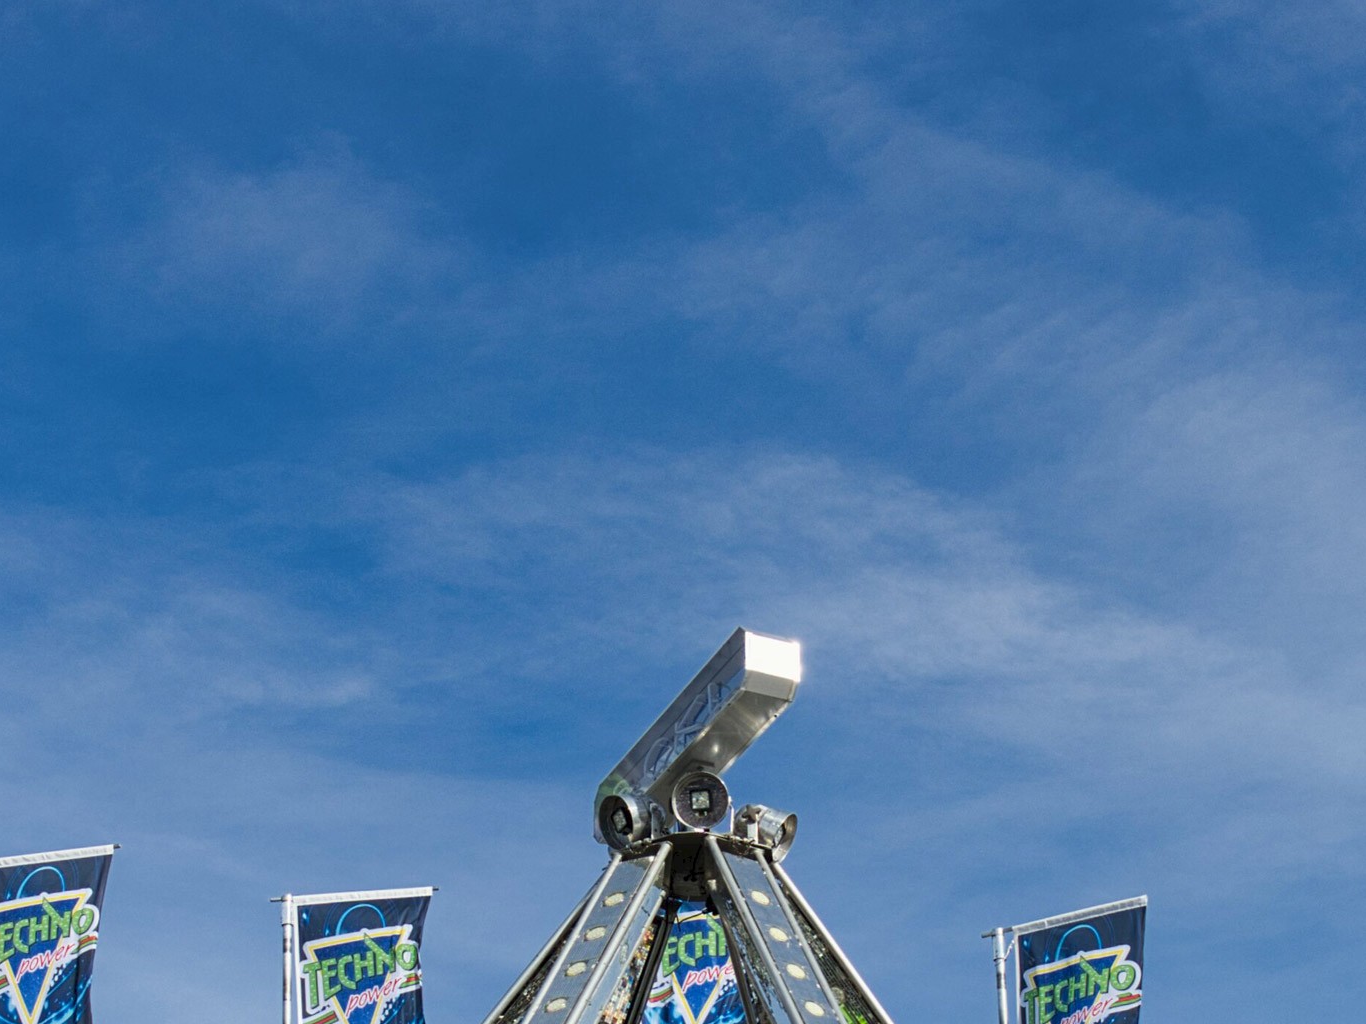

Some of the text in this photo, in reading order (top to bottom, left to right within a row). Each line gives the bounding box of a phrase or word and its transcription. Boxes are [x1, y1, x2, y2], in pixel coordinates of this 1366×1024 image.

[17, 943, 74, 981] power
[303, 932, 419, 1009] TECHNO
[683, 964, 735, 992] powe
[345, 976, 402, 1016] power
